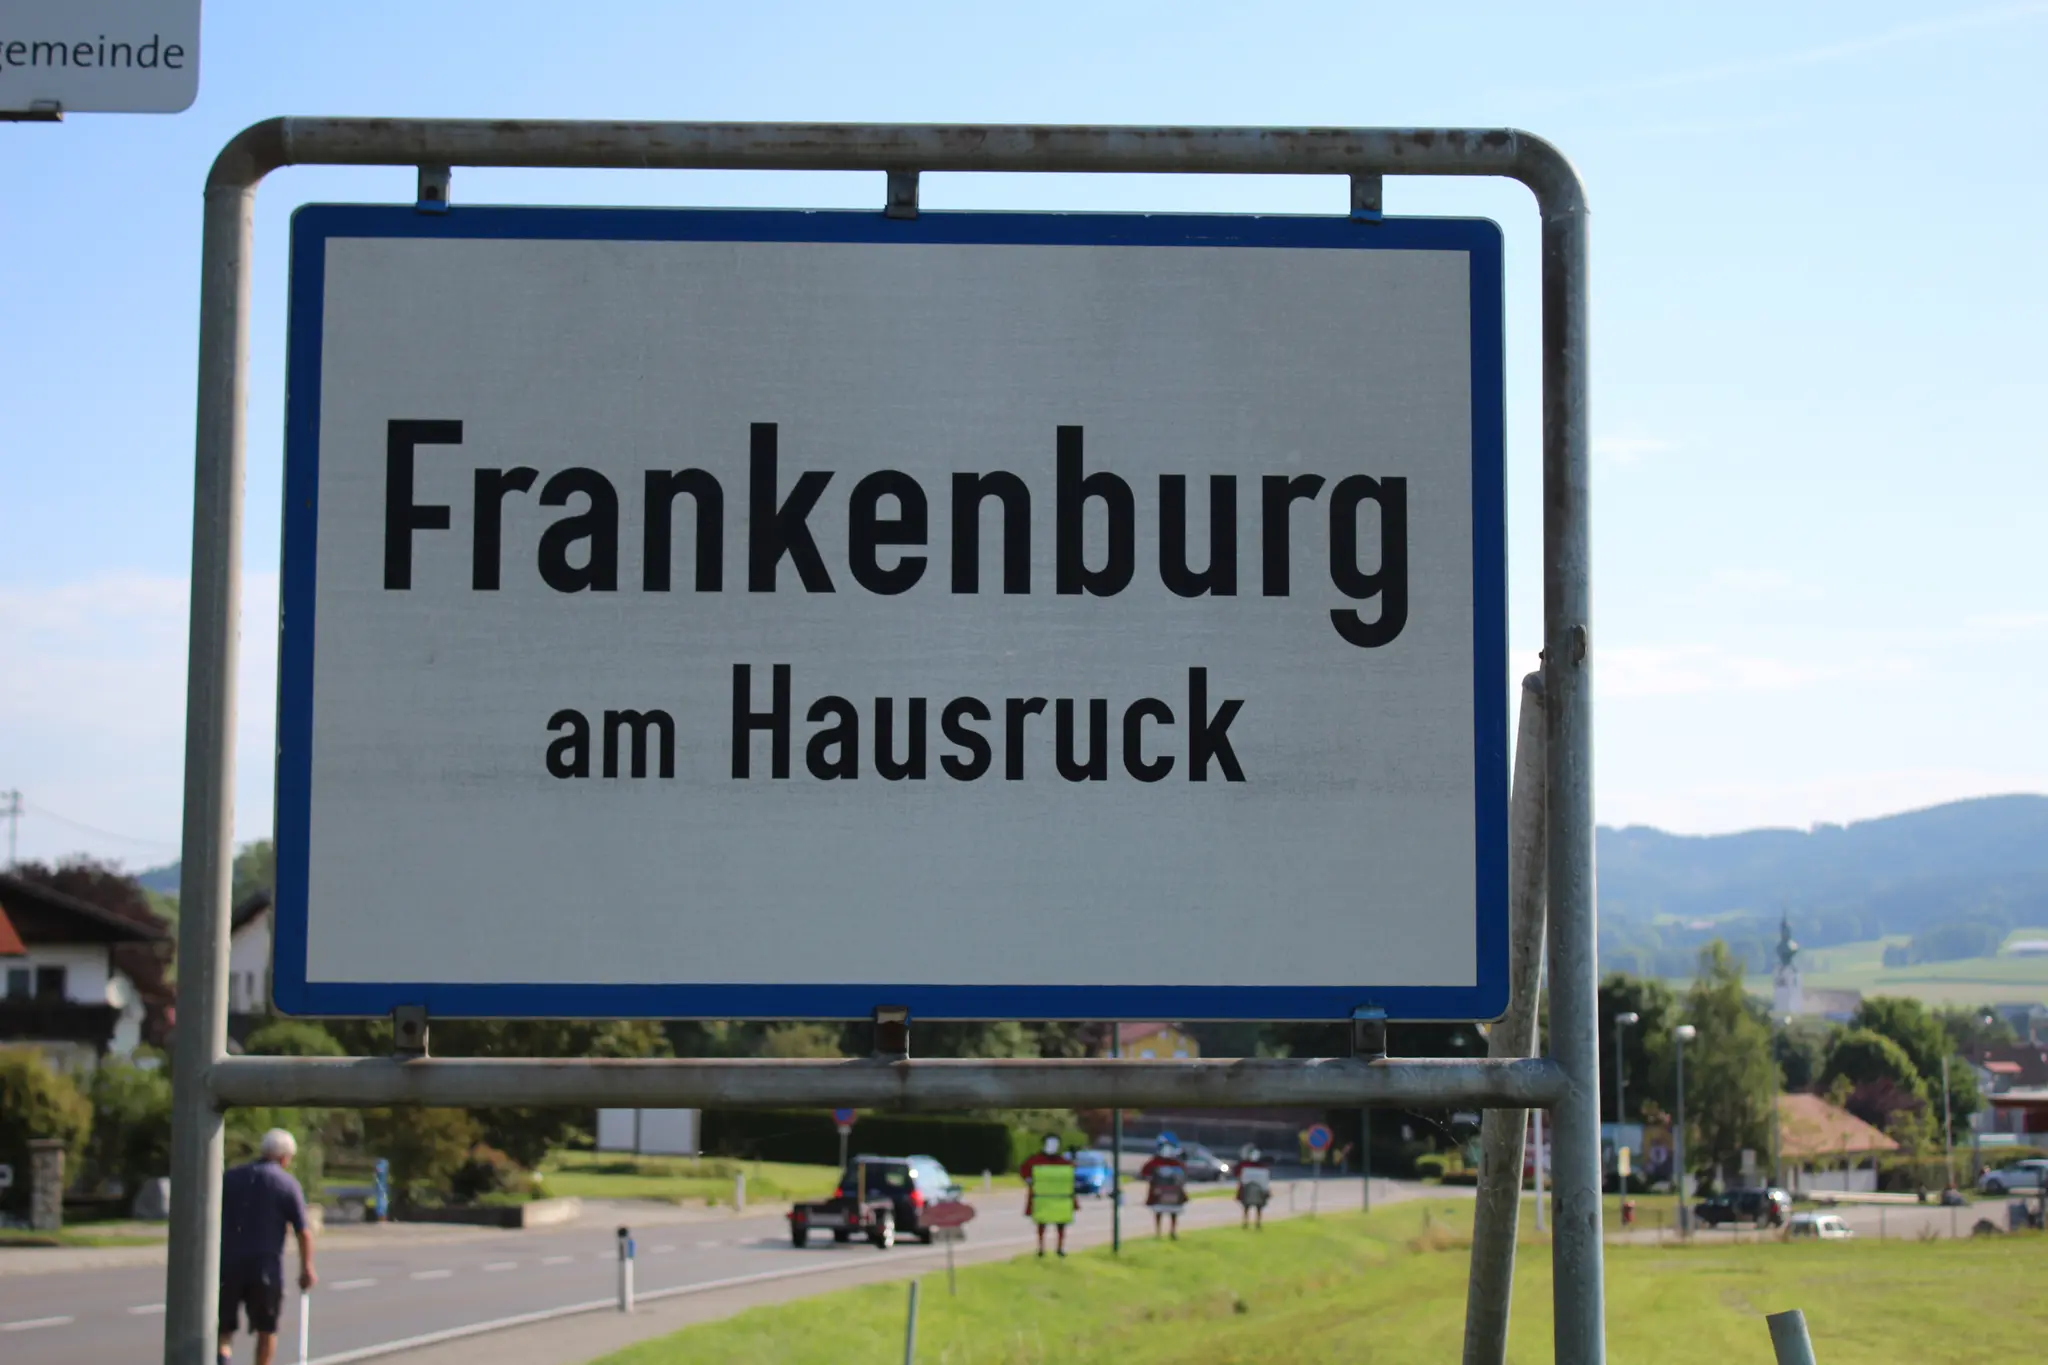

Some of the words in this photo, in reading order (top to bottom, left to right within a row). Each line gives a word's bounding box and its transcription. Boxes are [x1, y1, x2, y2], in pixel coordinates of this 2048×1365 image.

[0, 34, 185, 72] emeinde
[384, 419, 1408, 648] Frankenburg
[546, 708, 675, 780] am
[731, 664, 1247, 783] Hausruck
